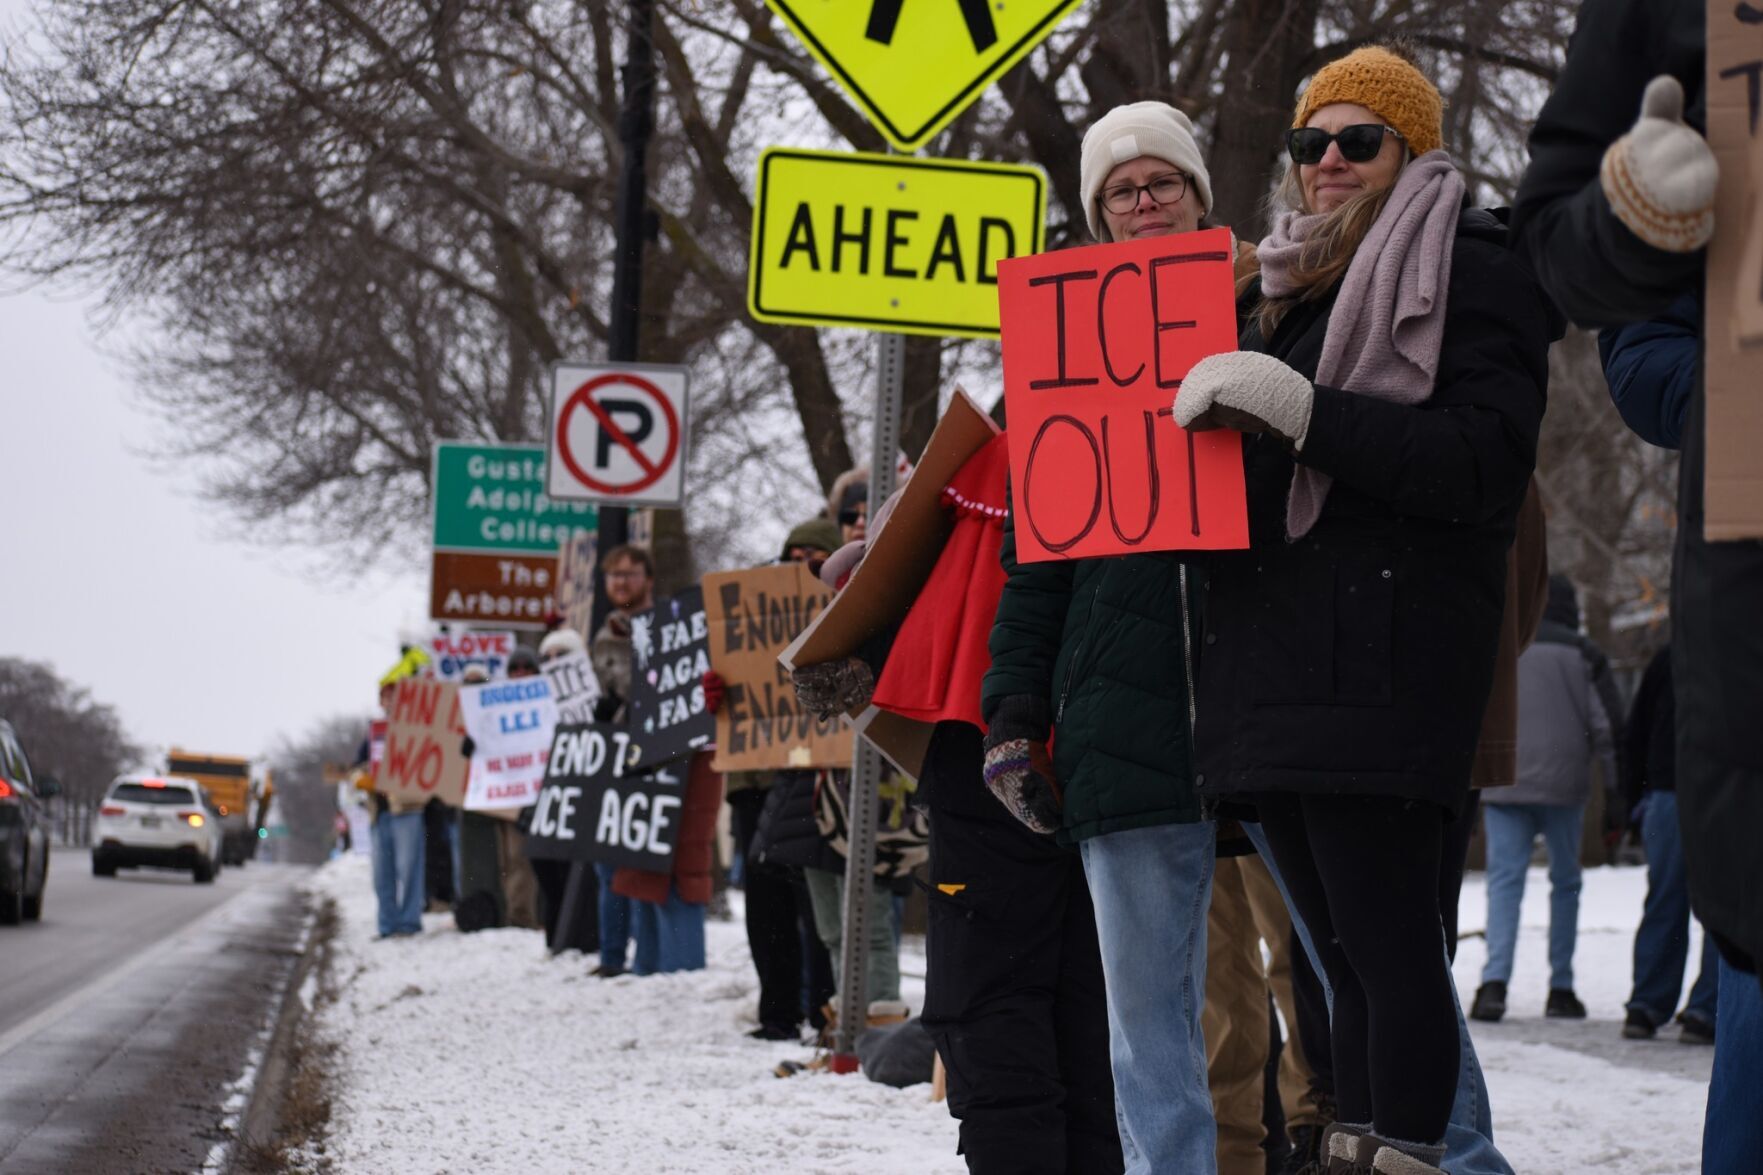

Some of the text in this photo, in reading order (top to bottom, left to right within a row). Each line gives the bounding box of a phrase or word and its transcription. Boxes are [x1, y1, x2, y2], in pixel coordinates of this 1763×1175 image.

[780, 202, 1016, 285] AHEAD
[1028, 251, 1228, 390] ICE
[595, 398, 654, 469] P
[1023, 408, 1204, 554] OUT
[498, 560, 550, 587] The
[446, 634, 508, 656] LOVE
[720, 583, 830, 653] ENOU
[393, 678, 442, 726] MN
[547, 659, 591, 703] ICE
[549, 730, 607, 778] END
[530, 785, 681, 856] ICE AGE
